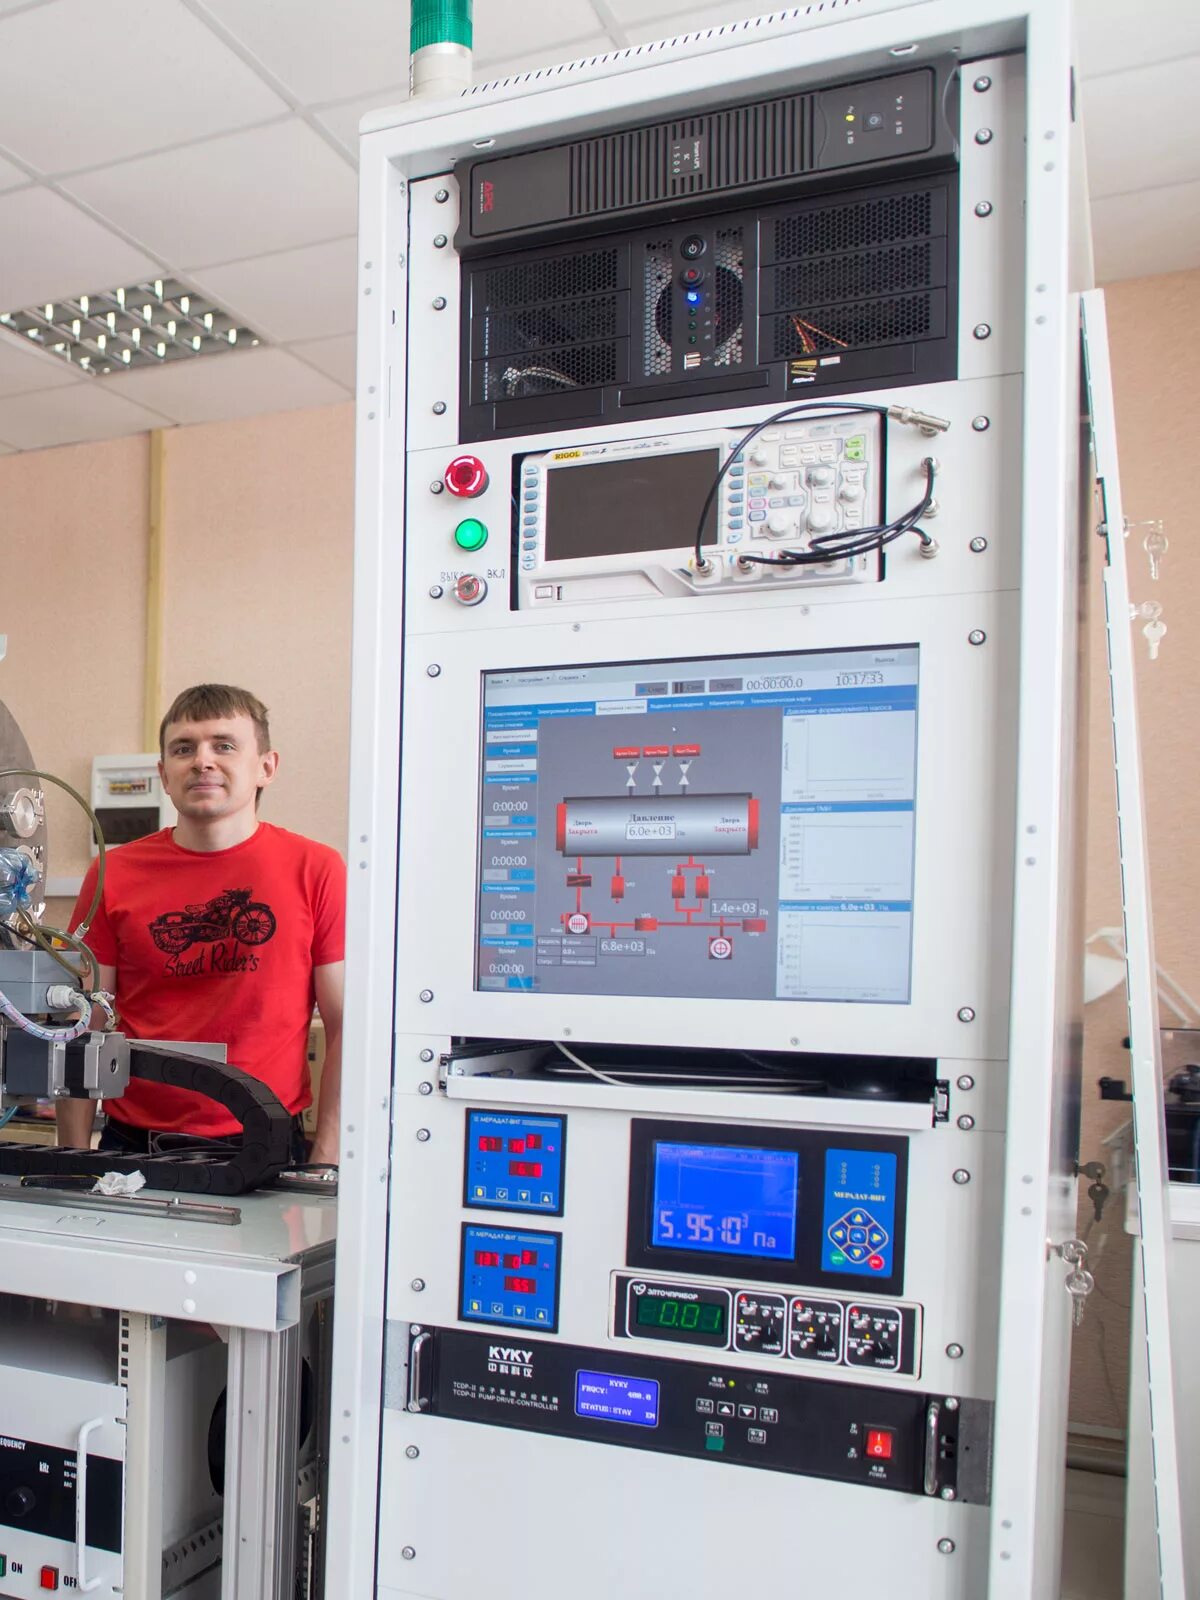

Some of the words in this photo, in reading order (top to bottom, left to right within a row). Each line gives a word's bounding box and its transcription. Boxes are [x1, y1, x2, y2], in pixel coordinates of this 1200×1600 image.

[483, 180, 496, 213] APC
[554, 450, 580, 460] RIGOL
[487, 568, 505, 579] ВКЛ
[746, 678, 803, 691] 00:00:00.0
[836, 673, 884, 687] 10:17:33
[493, 801, 528, 812] 0:00:00
[629, 814, 675, 823] Давление
[568, 828, 598, 837] Закрыта
[628, 826, 672, 837] 6.0e+03
[714, 825, 746, 835] Закрыта
[492, 856, 527, 866] 0:00:00
[712, 903, 757, 914] 1.4e+03
[490, 910, 526, 921] 0:00:00
[601, 940, 645, 952] 6.8e+03
[162, 948, 205, 978] Street
[489, 963, 524, 974] 0:00:00
[753, 1231, 777, 1249] Па
[659, 1301, 722, 1329] 0.01
[488, 1345, 533, 1363] KYKY
[609, 1379, 628, 1389] KYKY
[453, 1388, 476, 1398] TCDP-II
[478, 1393, 496, 1401] PUMP
[39, 1461, 50, 1473] kHz
[11, 1561, 23, 1574] ON
